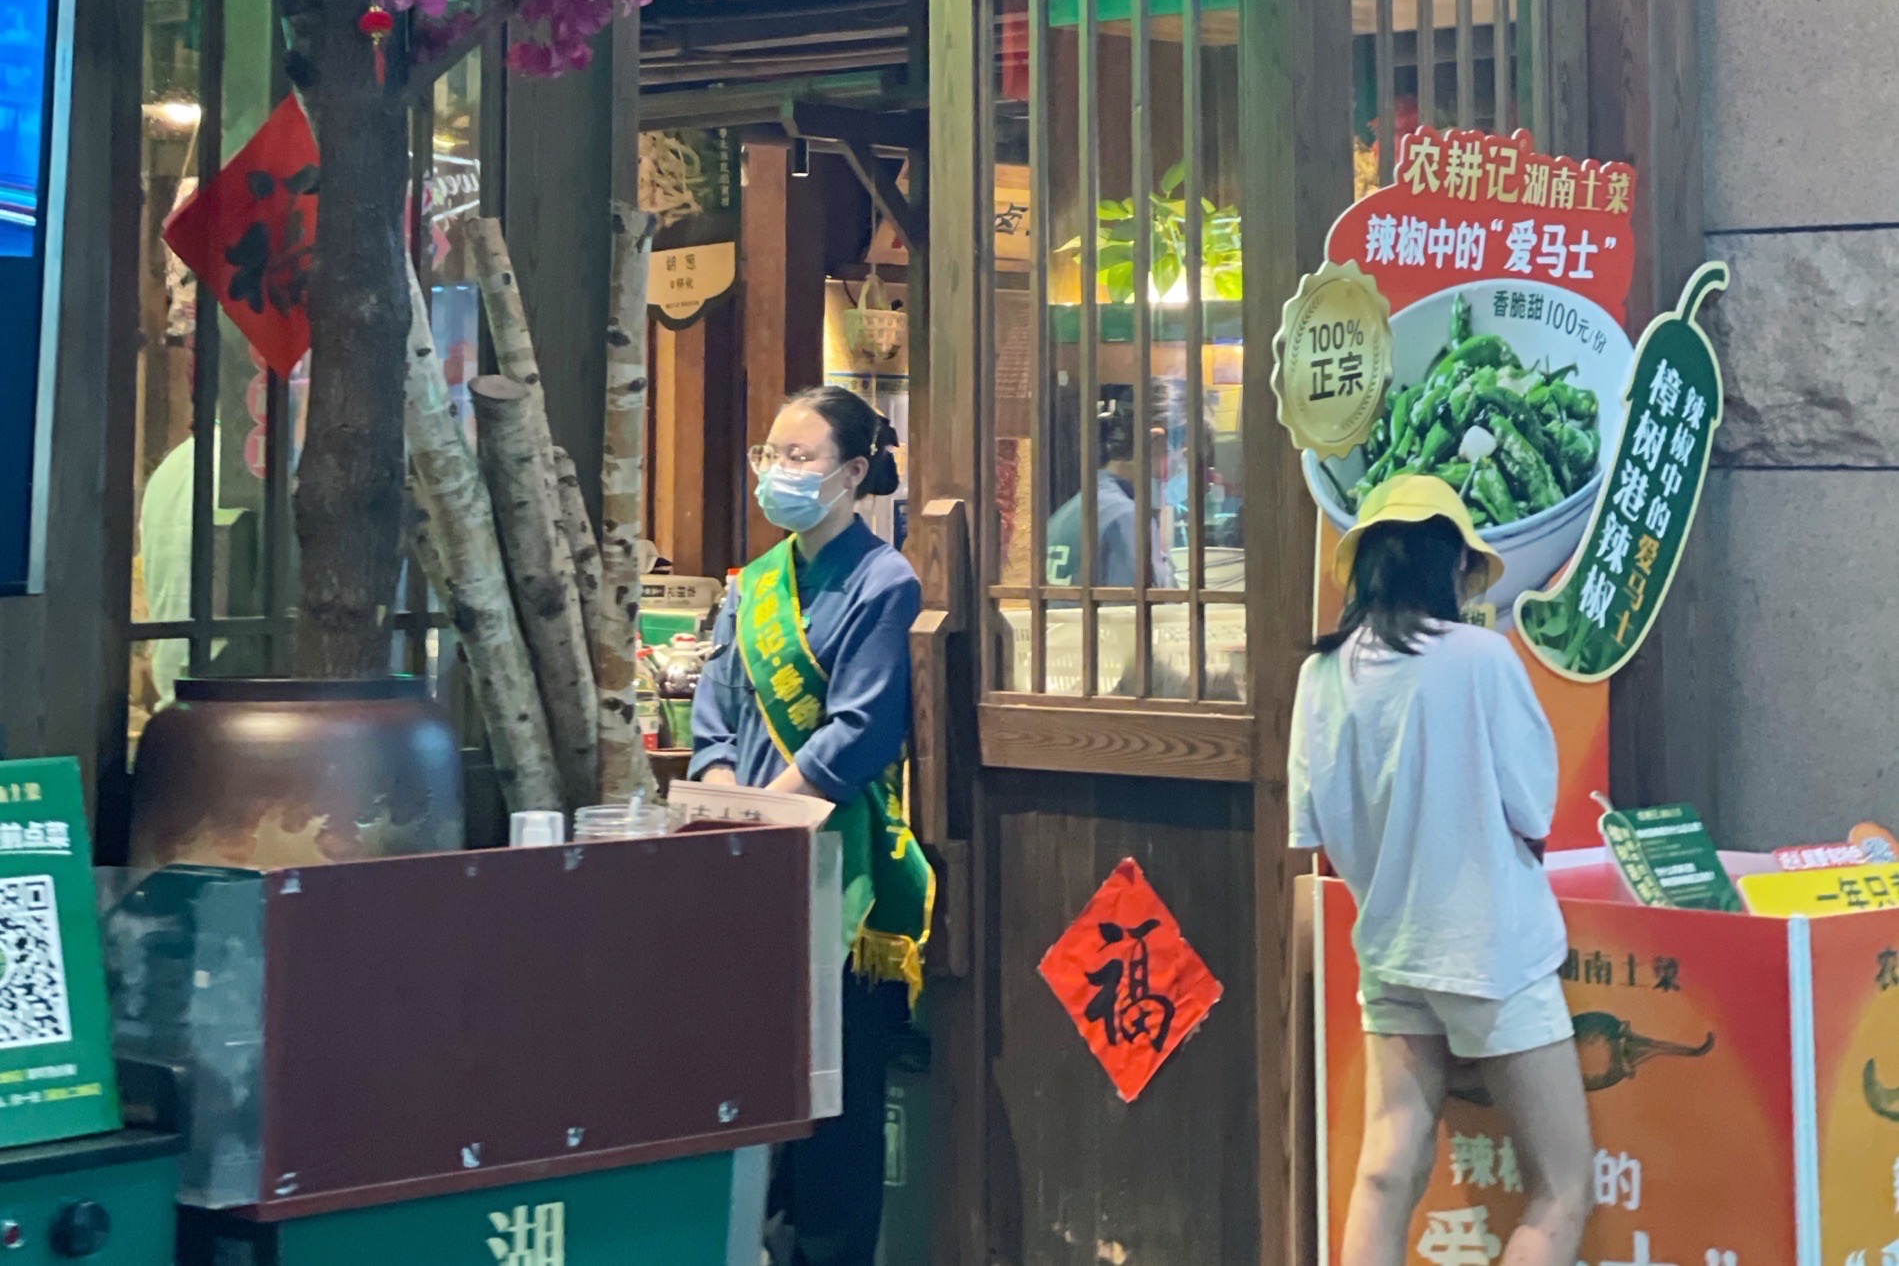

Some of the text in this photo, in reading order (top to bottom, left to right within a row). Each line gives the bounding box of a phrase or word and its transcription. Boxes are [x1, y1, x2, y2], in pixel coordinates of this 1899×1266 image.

[1403, 137, 1632, 215] 农耕记 湖南土菜
[1308, 319, 1363, 354] 100%
[1309, 351, 1363, 401] 正宗
[1579, 358, 1682, 628] 樟树港辣椒
[1084, 919, 1175, 1052] 福
